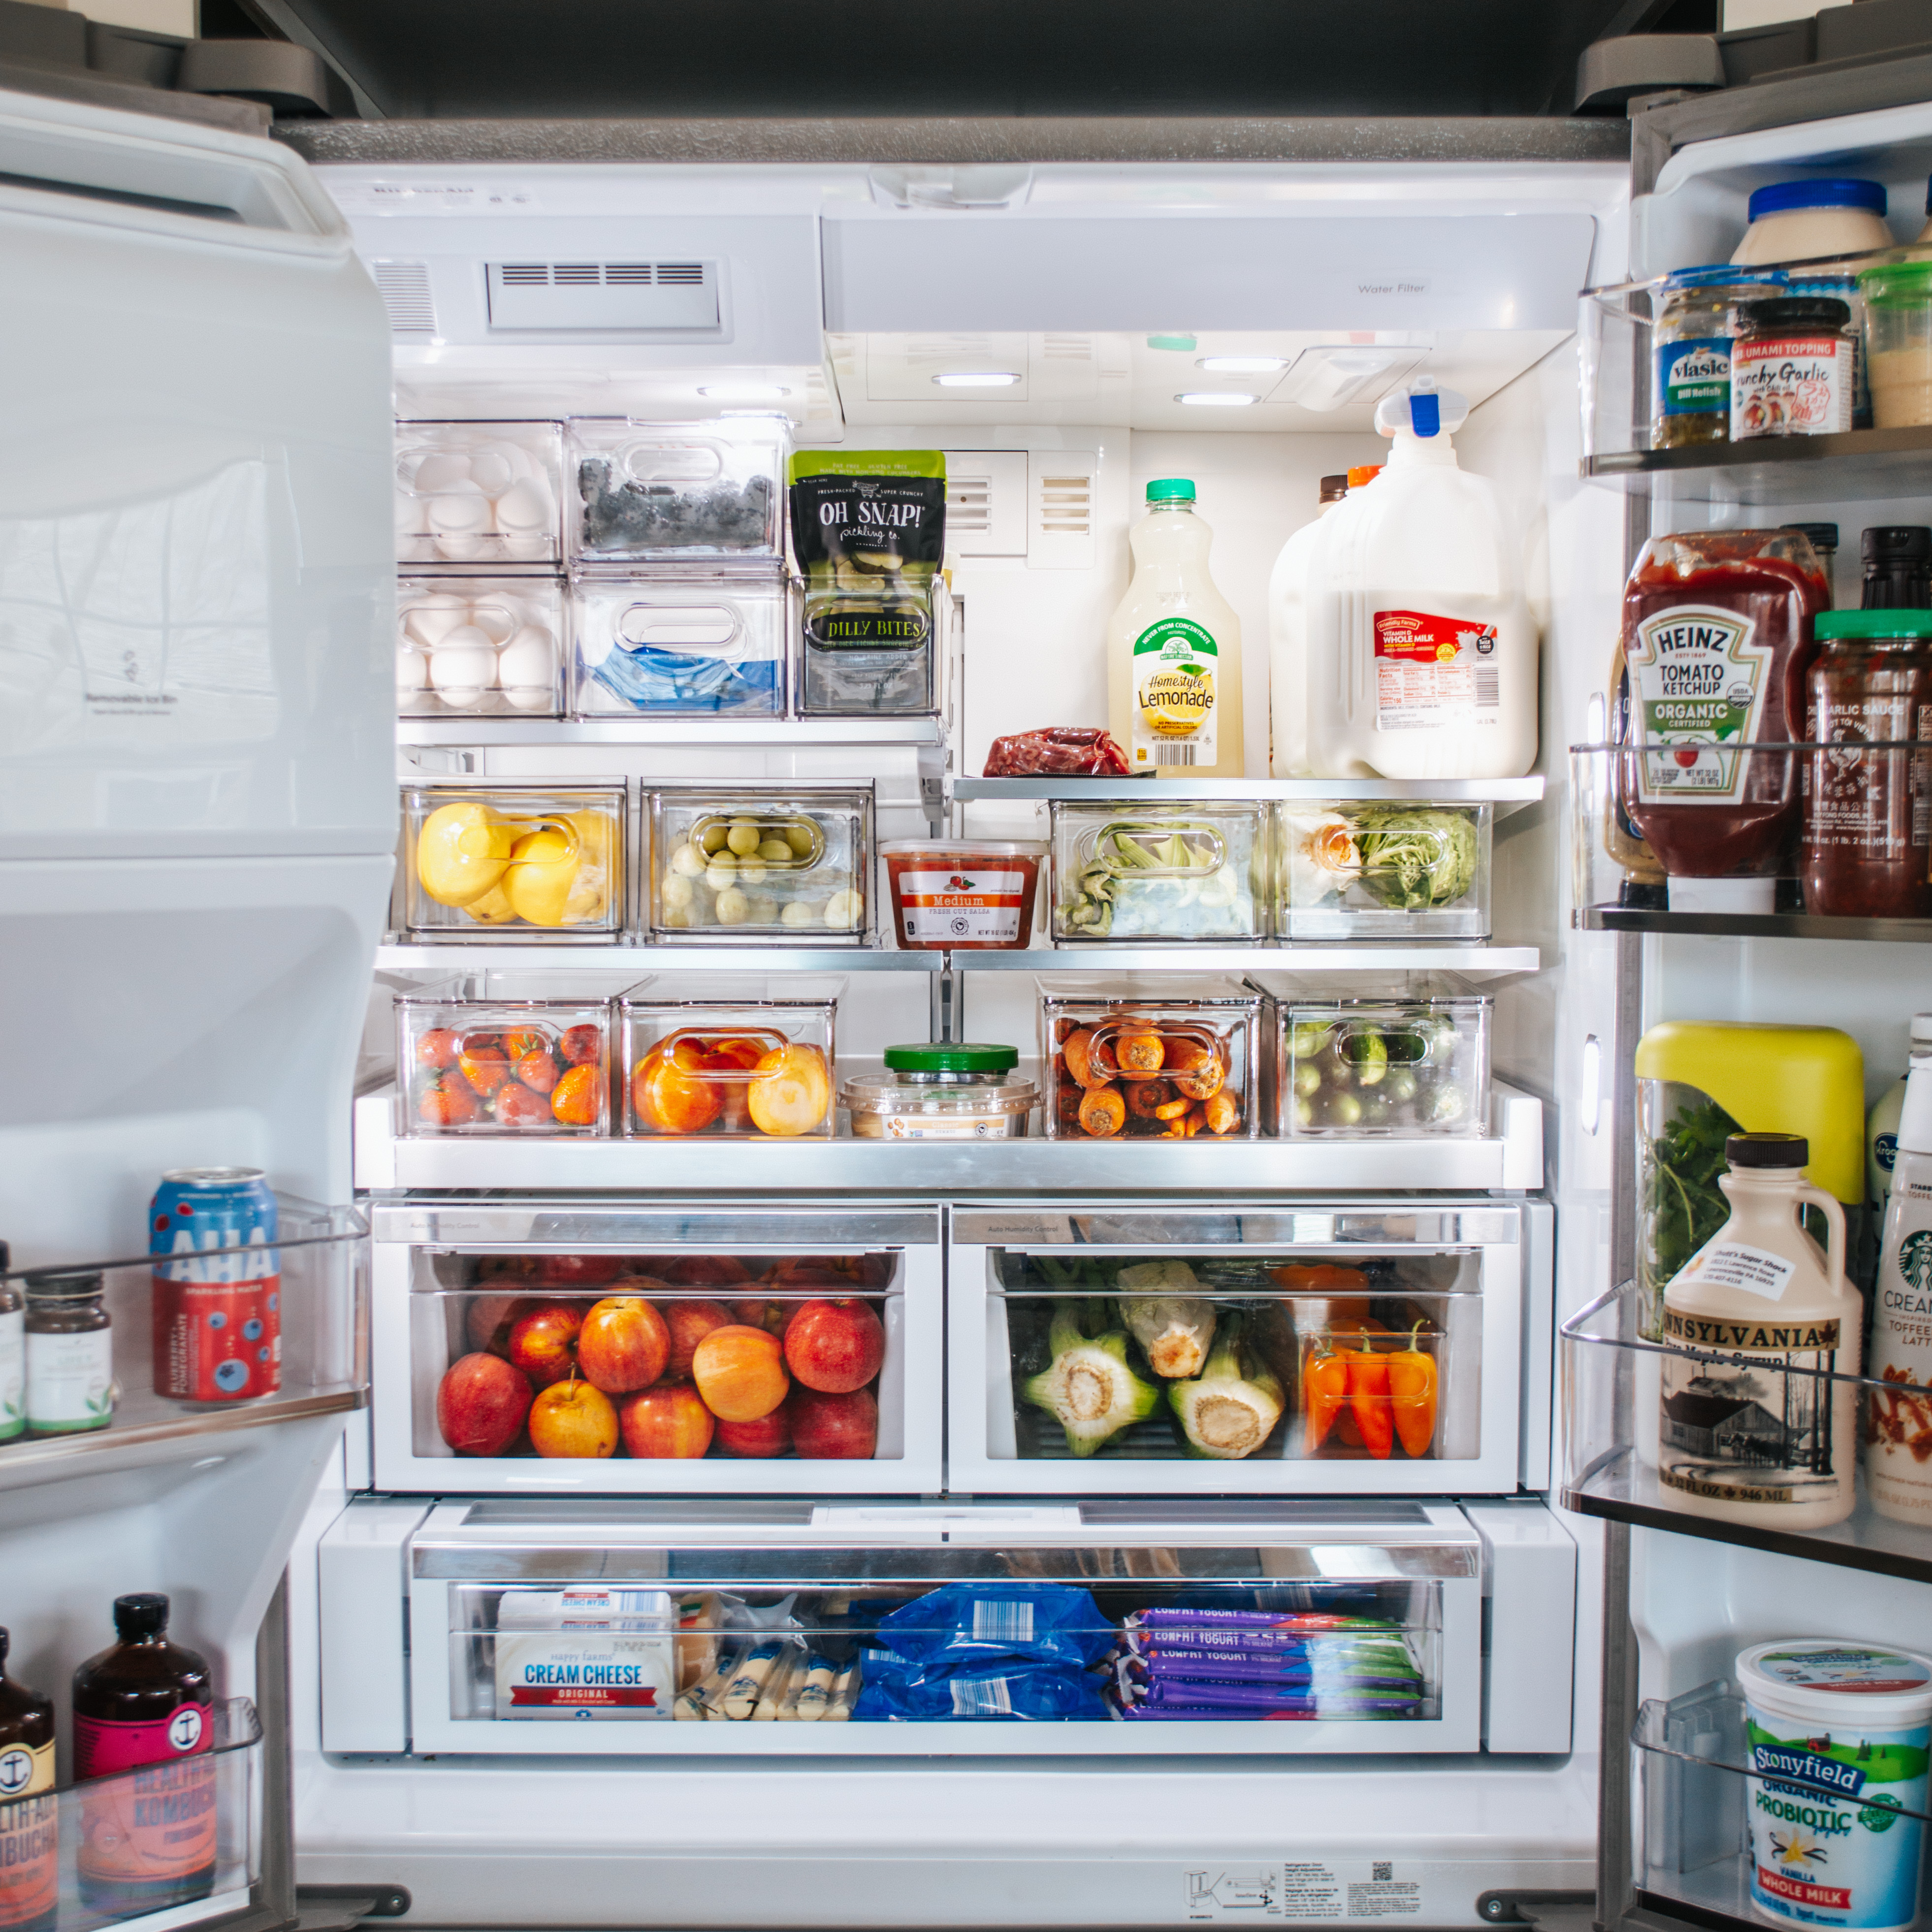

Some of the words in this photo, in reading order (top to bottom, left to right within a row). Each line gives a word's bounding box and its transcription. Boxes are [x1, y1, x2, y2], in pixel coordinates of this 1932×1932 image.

[1358, 285, 1393, 294] Water
[1397, 284, 1425, 293] Filter
[1746, 345, 1782, 358] UMAMI
[1785, 343, 1831, 354] TOPPING
[1674, 359, 1728, 378] vlasic
[1736, 365, 1776, 386] runchy
[1778, 362, 1829, 381] Garlic
[1678, 388, 1691, 399] Dill
[1692, 387, 1721, 398] Relish
[820, 502, 848, 526] OH
[858, 501, 922, 528] SNAP!
[840, 525, 885, 544] pickling
[889, 531, 900, 540] co.
[829, 620, 871, 637] DILLY
[877, 620, 920, 637] BITES
[1142, 629, 1159, 644] NEVER
[1158, 623, 1174, 632] FROM
[1175, 622, 1211, 644] CONCENTRATE
[1383, 635, 1413, 644] WHOLE
[1414, 634, 1434, 642] MILK
[1658, 627, 1729, 654] HEINZ
[1660, 664, 1724, 681] TOMATO
[1148, 675, 1203, 692] Homestyle
[1663, 682, 1720, 695] KETCHUP
[1139, 690, 1213, 708] Lemonade
[1655, 703, 1728, 719] ORGANIC
[1863, 705, 1904, 715] SAUCE
[934, 896, 984, 906] Medium
[1907, 1191, 1932, 1200] TOFFE
[1910, 1183, 1932, 1191] STARB
[170, 1226, 272, 1284] AHA
[1739, 1253, 1762, 1263] Sugar
[1763, 1260, 1787, 1274] Shack
[1707, 1267, 1744, 1277] Lawrenceville
[1729, 1261, 1758, 1271] Lawrence
[1758, 1268, 1775, 1278] Road
[1884, 1290, 1932, 1314] CREA
[1666, 1312, 1822, 1347] NNSYLVANIA
[1889, 1320, 1932, 1336] TOFFEE
[1902, 1335, 1932, 1347] LATT
[1686, 1480, 1699, 1493] FL
[1702, 1483, 1720, 1497] OZ
[1740, 1488, 1762, 1501] 946
[1765, 1489, 1787, 1501] ML
[1198, 1609, 1237, 1617] YOGURT
[1200, 1632, 1239, 1645] YOGURT
[1207, 1652, 1247, 1661] YOGURT
[525, 1664, 580, 1683] CREAM
[583, 1665, 642, 1684] CHEESE
[558, 1689, 609, 1698] ORIGINAL
[1756, 1747, 1858, 1790] Stonyfield
[1763, 1779, 1838, 1808] ORGANIC
[1756, 1789, 1852, 1831] PROBIOTIC
[1761, 1871, 1803, 1897] WHOLE
[1806, 1888, 1841, 1904] MILK
